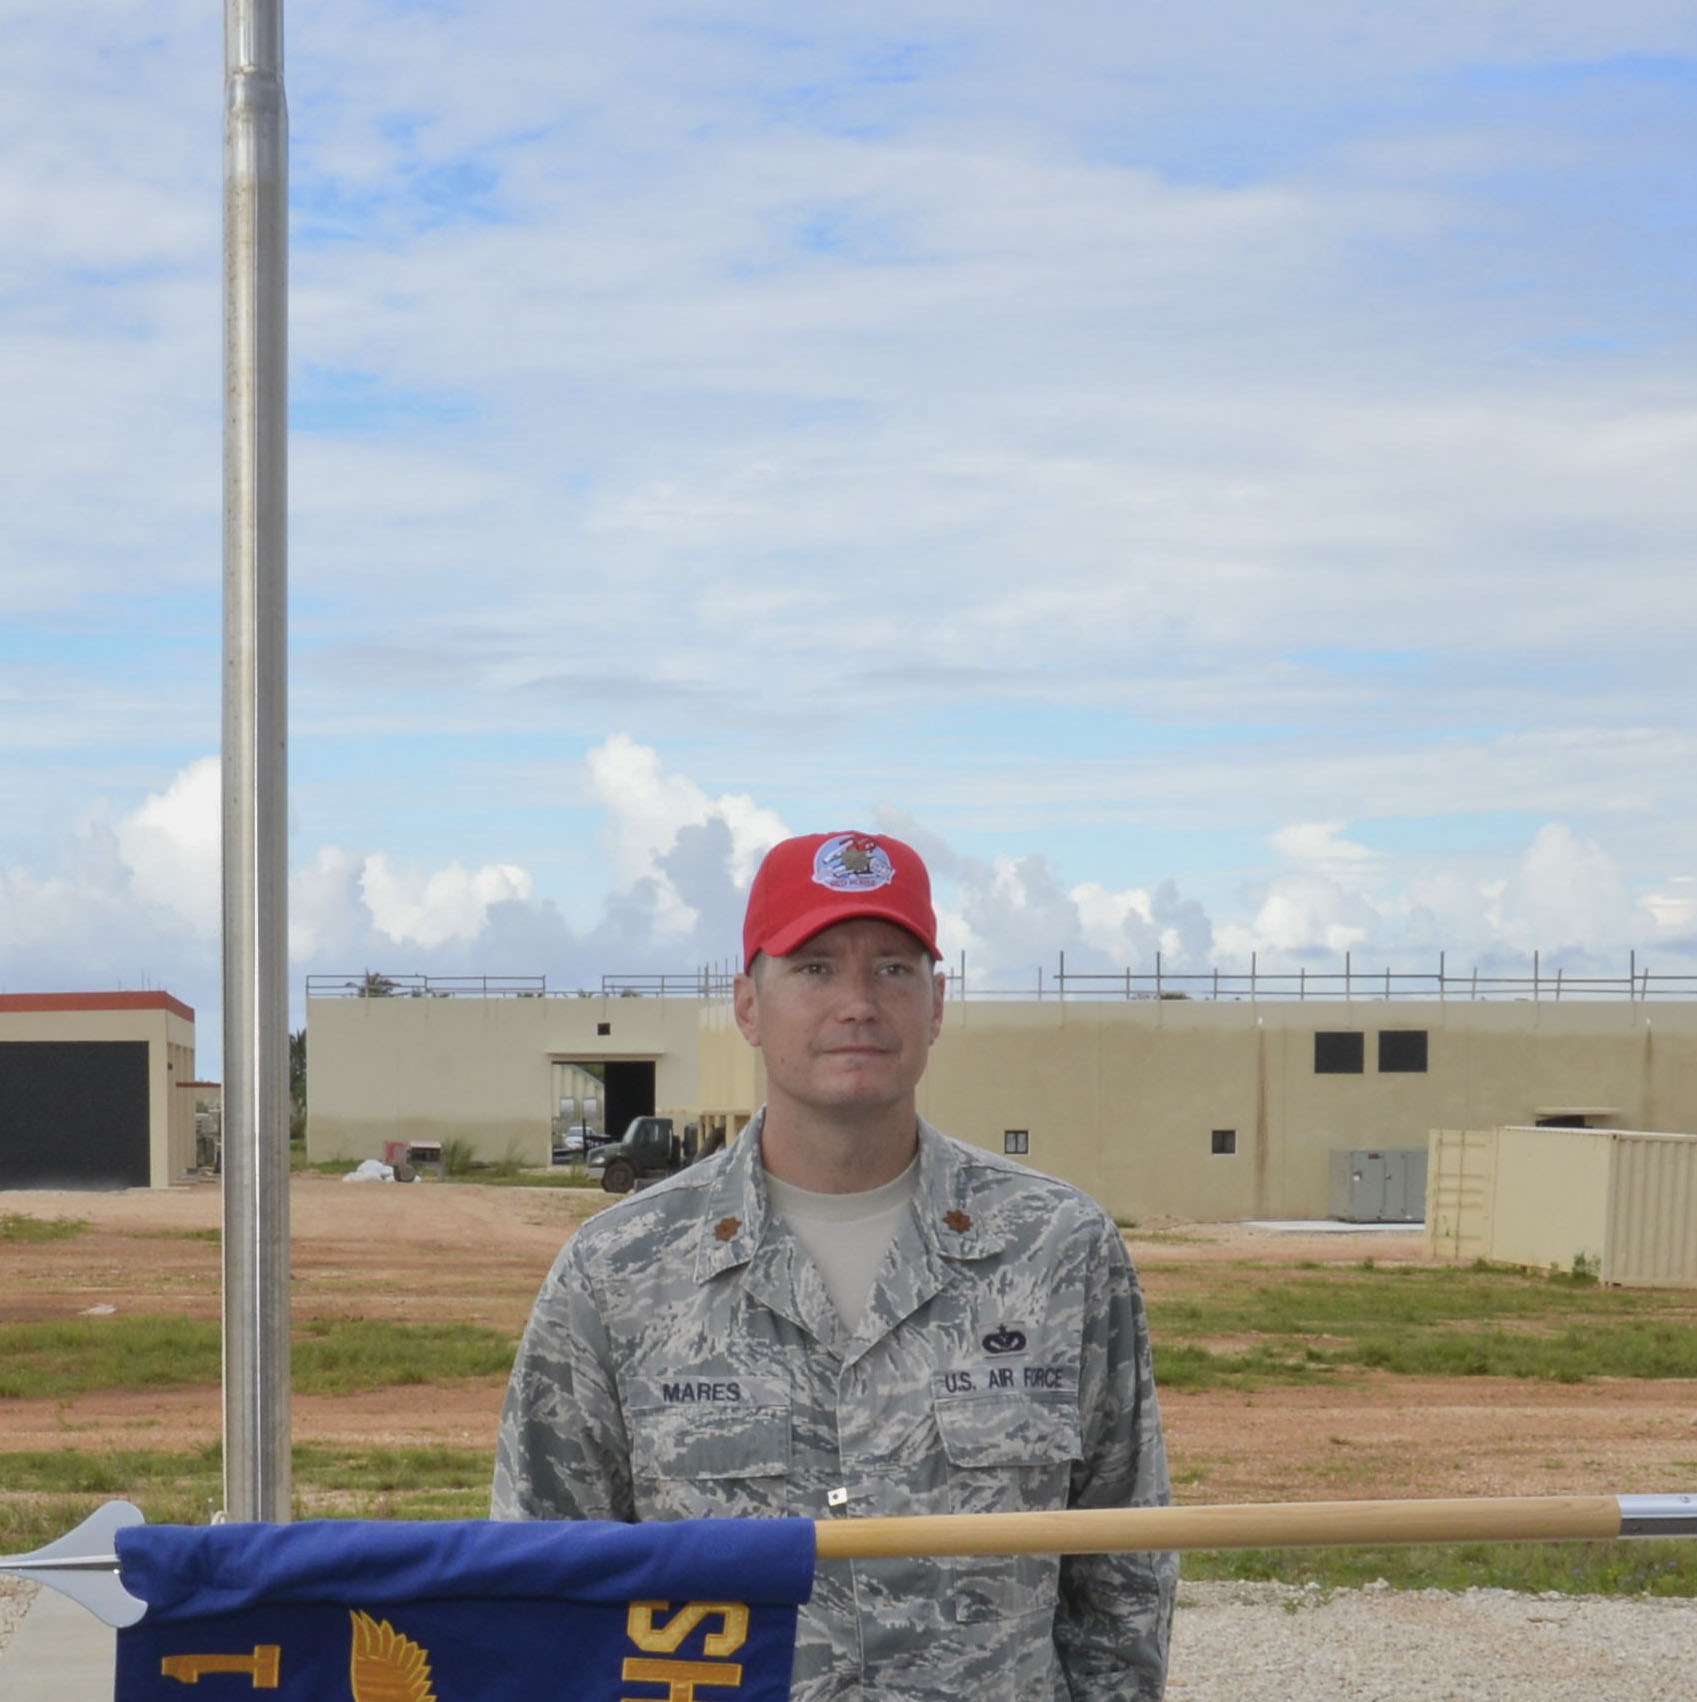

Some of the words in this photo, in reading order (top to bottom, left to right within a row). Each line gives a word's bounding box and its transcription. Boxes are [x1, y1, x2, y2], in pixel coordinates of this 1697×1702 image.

[663, 1382, 741, 1402] MARES
[945, 1371, 977, 1394] U.S.
[988, 1367, 1015, 1389] AIR
[1023, 1366, 1064, 1389] FORCE
[160, 1643, 281, 1689] 1
